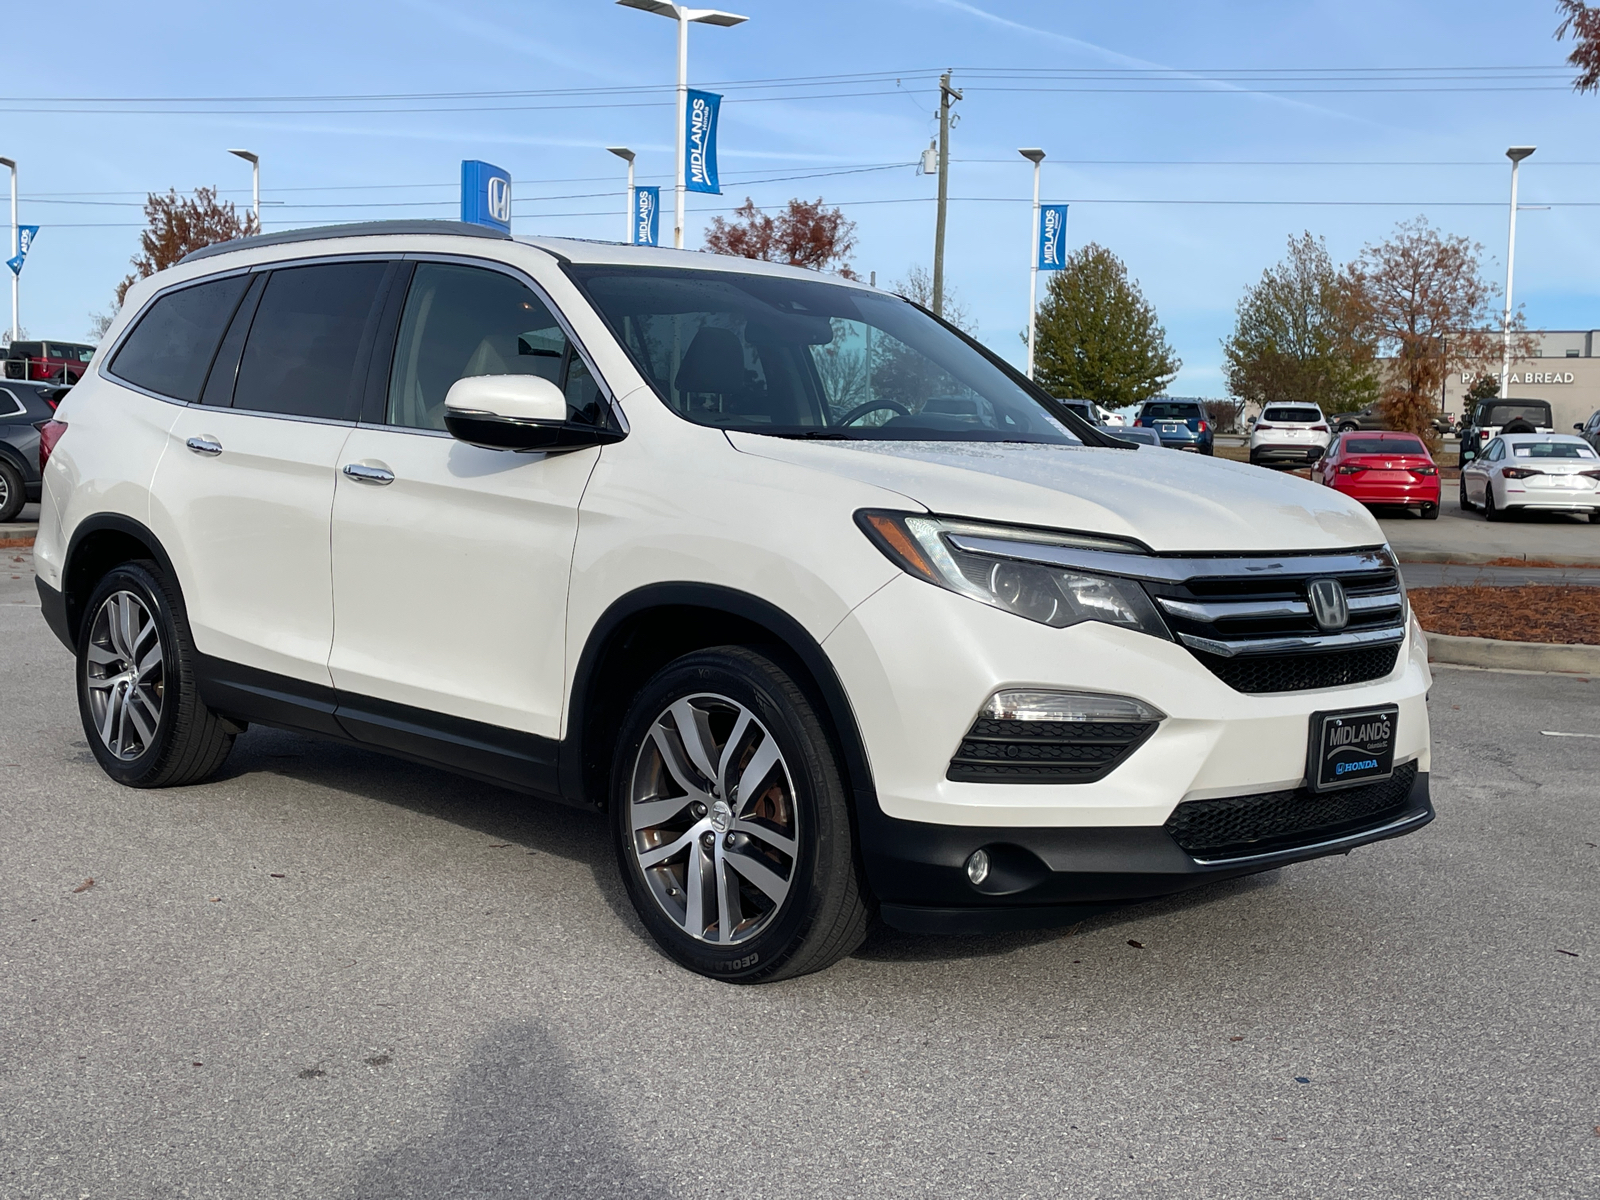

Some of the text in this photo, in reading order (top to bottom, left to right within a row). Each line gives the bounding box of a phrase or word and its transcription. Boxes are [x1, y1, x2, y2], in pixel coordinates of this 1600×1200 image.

[690, 98, 705, 183] MIDLANDS
[639, 190, 649, 243] MIDLANDS
[1044, 209, 1055, 264] MIDLANDS
[1461, 372, 1575, 384] PAEA BREAD
[1329, 720, 1391, 746] MIDLANDS
[1344, 759, 1378, 772] HONDA
